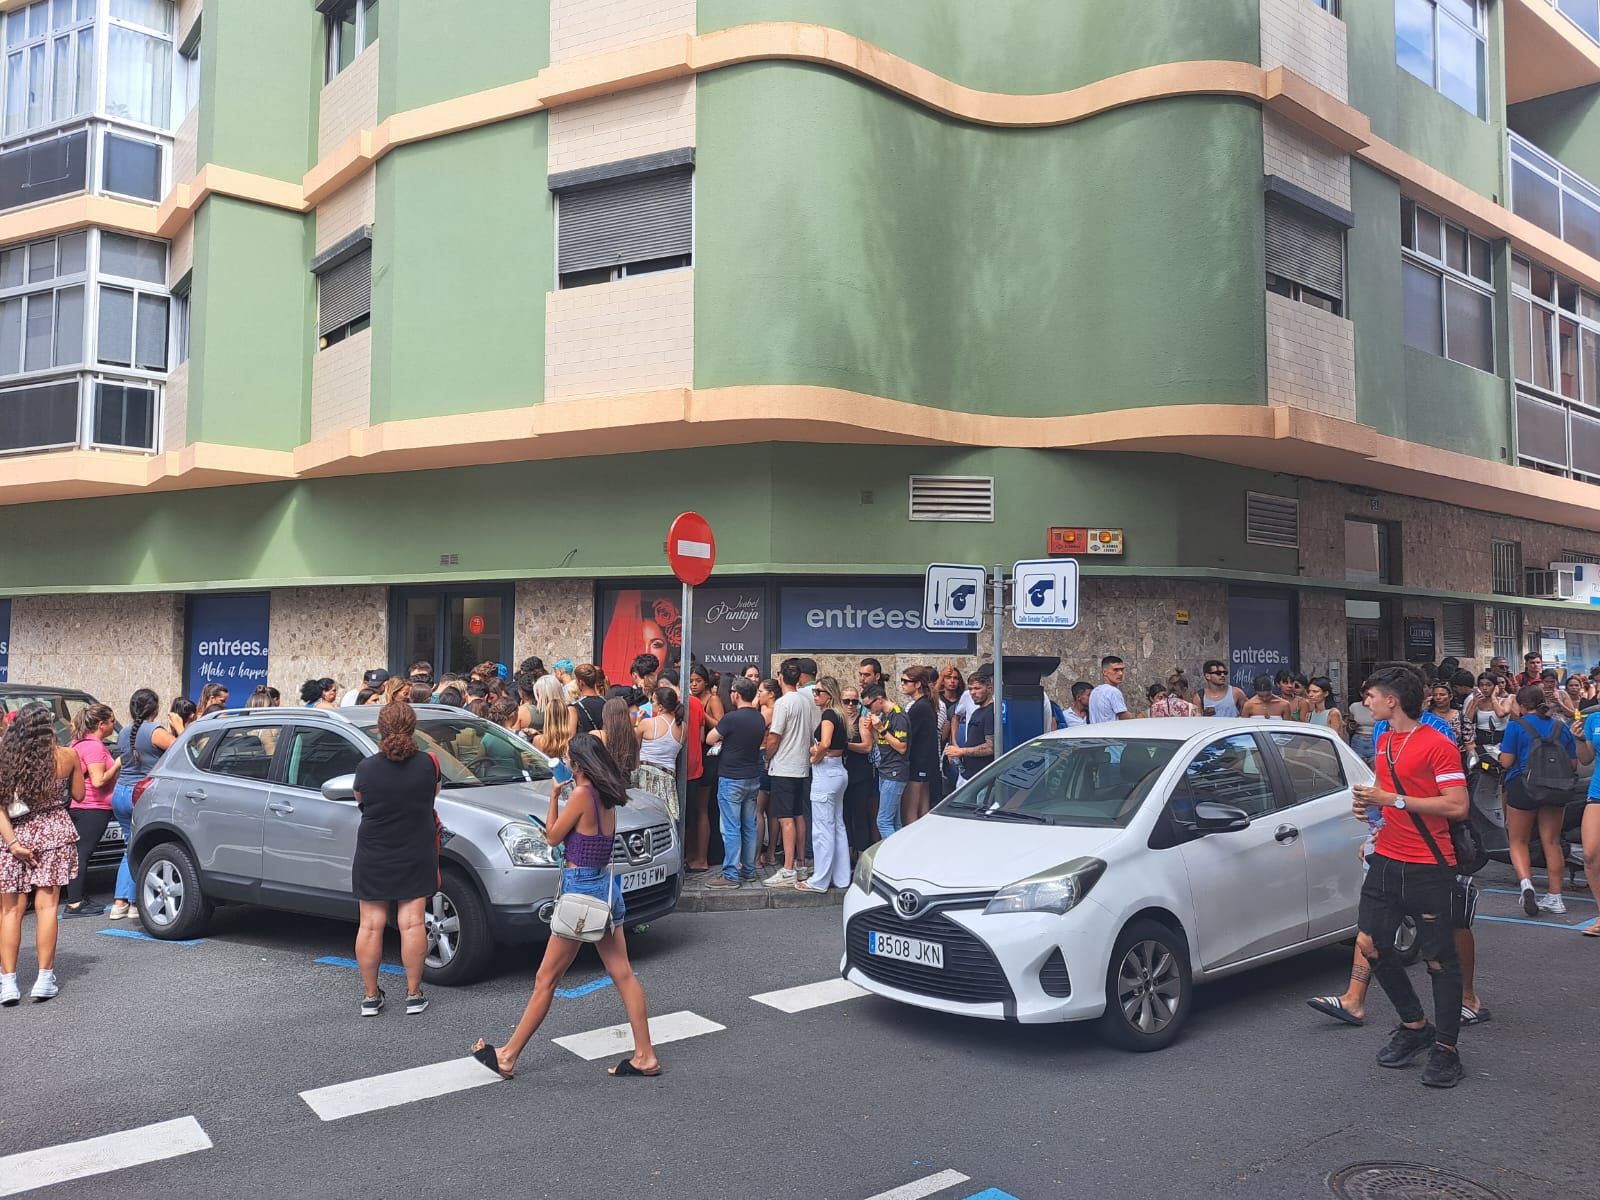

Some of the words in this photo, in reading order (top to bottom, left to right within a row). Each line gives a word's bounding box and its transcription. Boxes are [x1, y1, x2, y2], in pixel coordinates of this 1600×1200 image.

[729, 594, 760, 610] Isabel
[705, 601, 760, 632] Pantoja
[720, 643, 744, 651] TOUR
[1232, 646, 1289, 664] entrées.es
[704, 652, 760, 663] ENAMÓRATE
[198, 661, 226, 682] Make
[228, 665, 237, 678] it
[623, 871, 647, 890] 2719
[878, 935, 910, 958] 8508
[915, 941, 941, 965] JKN
